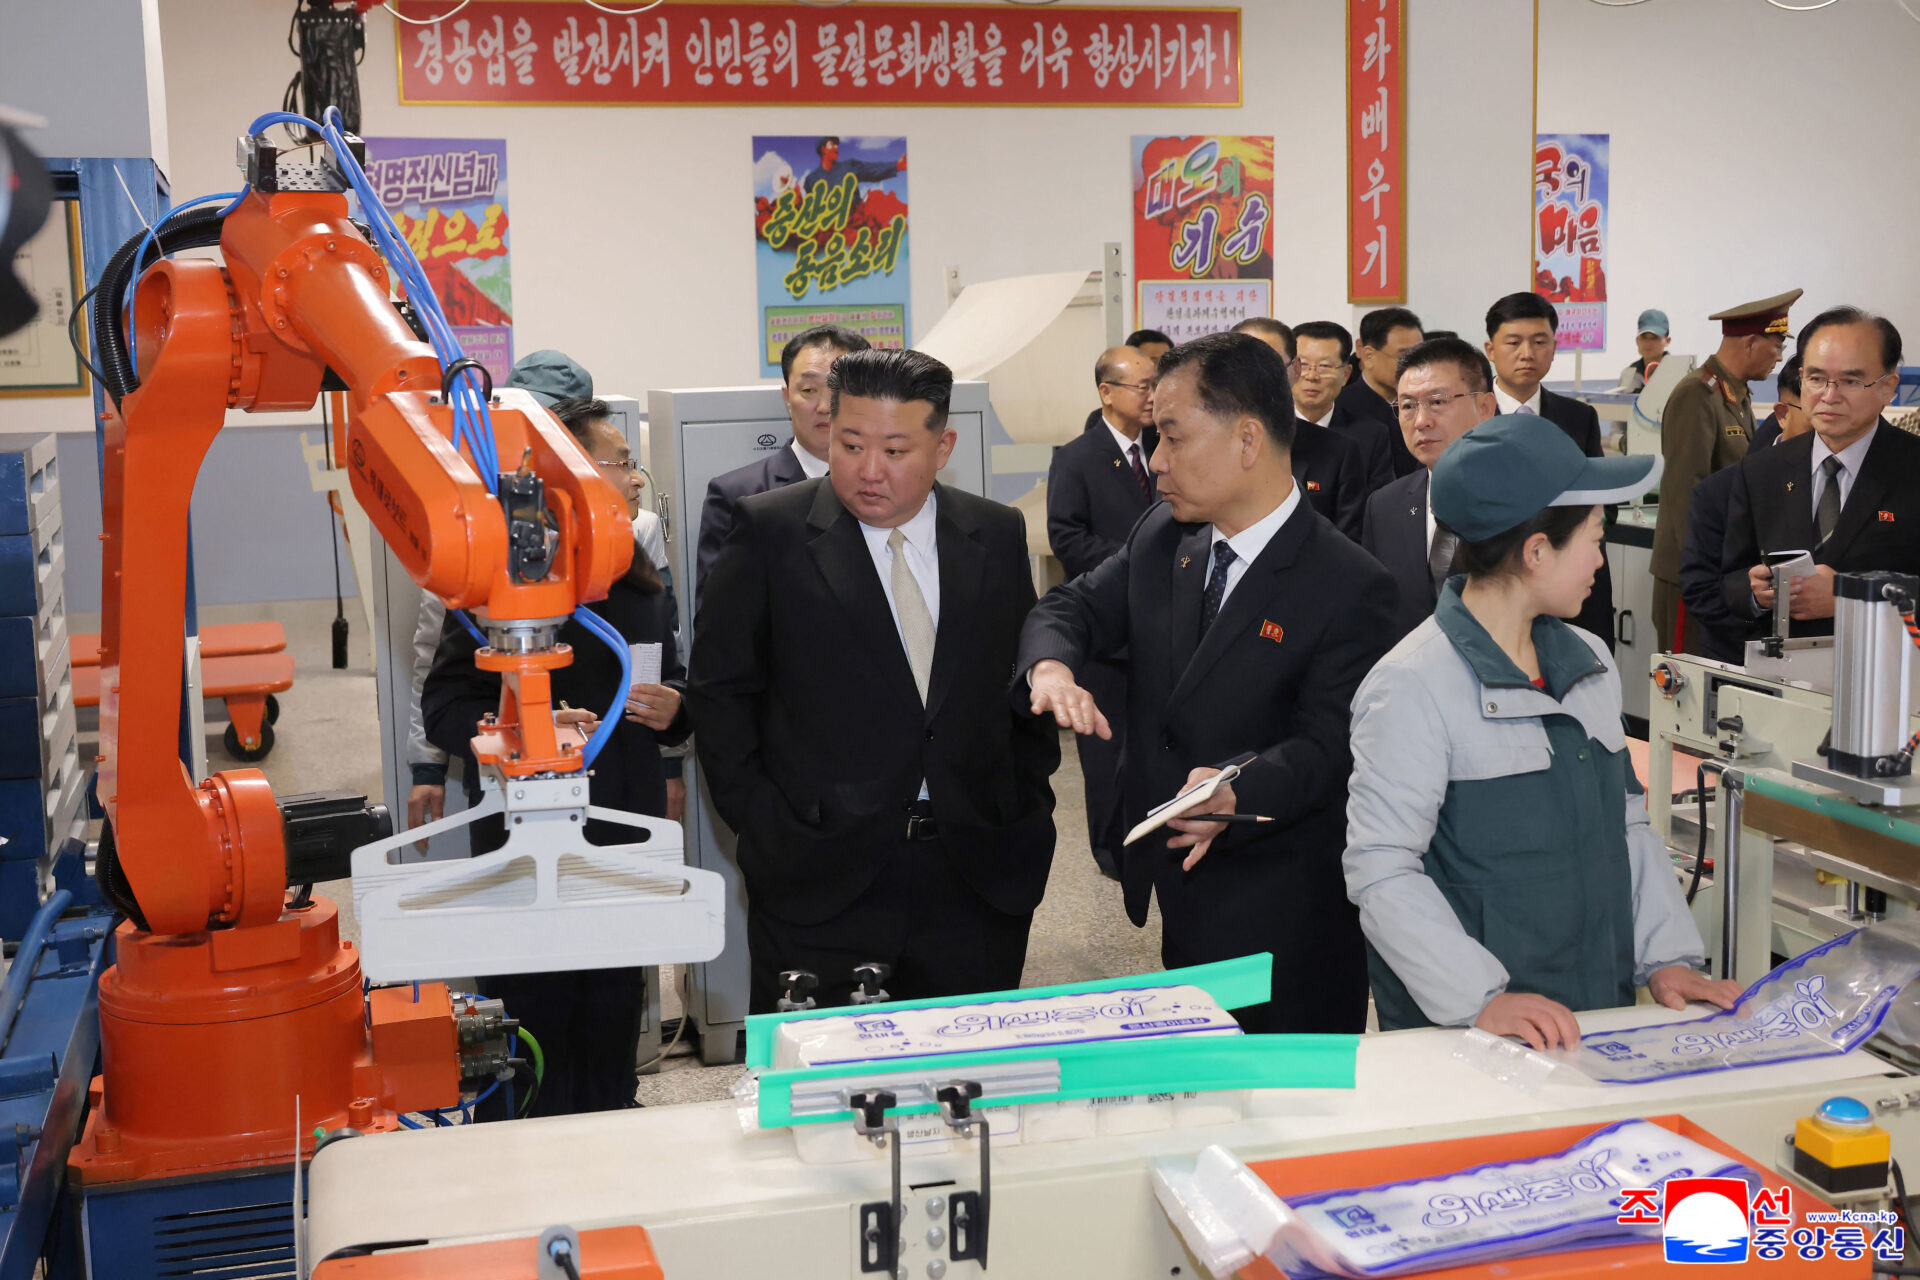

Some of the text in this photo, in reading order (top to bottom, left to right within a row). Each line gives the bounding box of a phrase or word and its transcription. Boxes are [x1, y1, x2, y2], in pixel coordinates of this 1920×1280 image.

[414, 15, 1231, 89] 경공업을 발전시켜 인민들의 물질문화생활을 더욱 향상시키자!
[1360, 0, 1391, 289] 라배우기
[383, 203, 503, 266] 심으로
[1537, 201, 1602, 258] 마음
